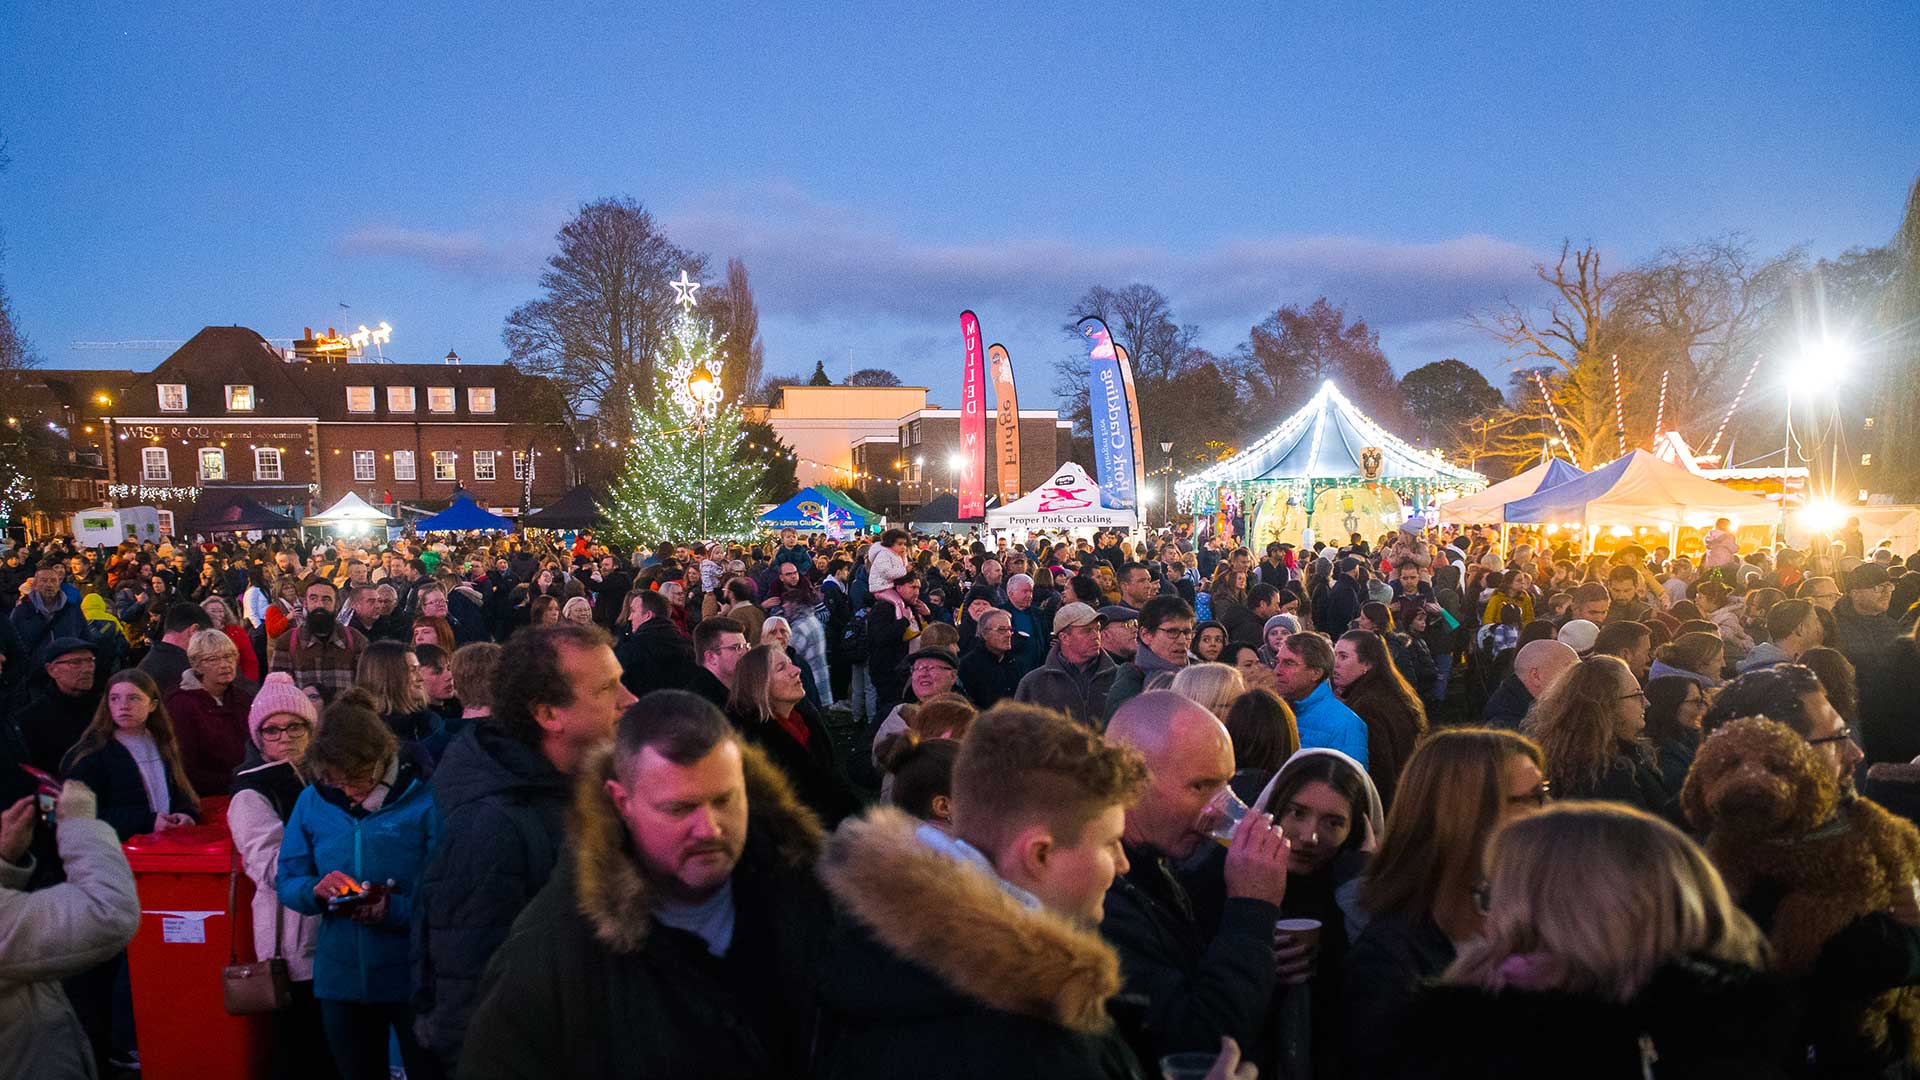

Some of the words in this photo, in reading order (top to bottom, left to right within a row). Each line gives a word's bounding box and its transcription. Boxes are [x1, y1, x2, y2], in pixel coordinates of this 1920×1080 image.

[171, 427, 181, 438] &
[1009, 516, 1040, 526] Proper
[1042, 515, 1064, 524] Pork
[1066, 514, 1112, 525] Crackling
